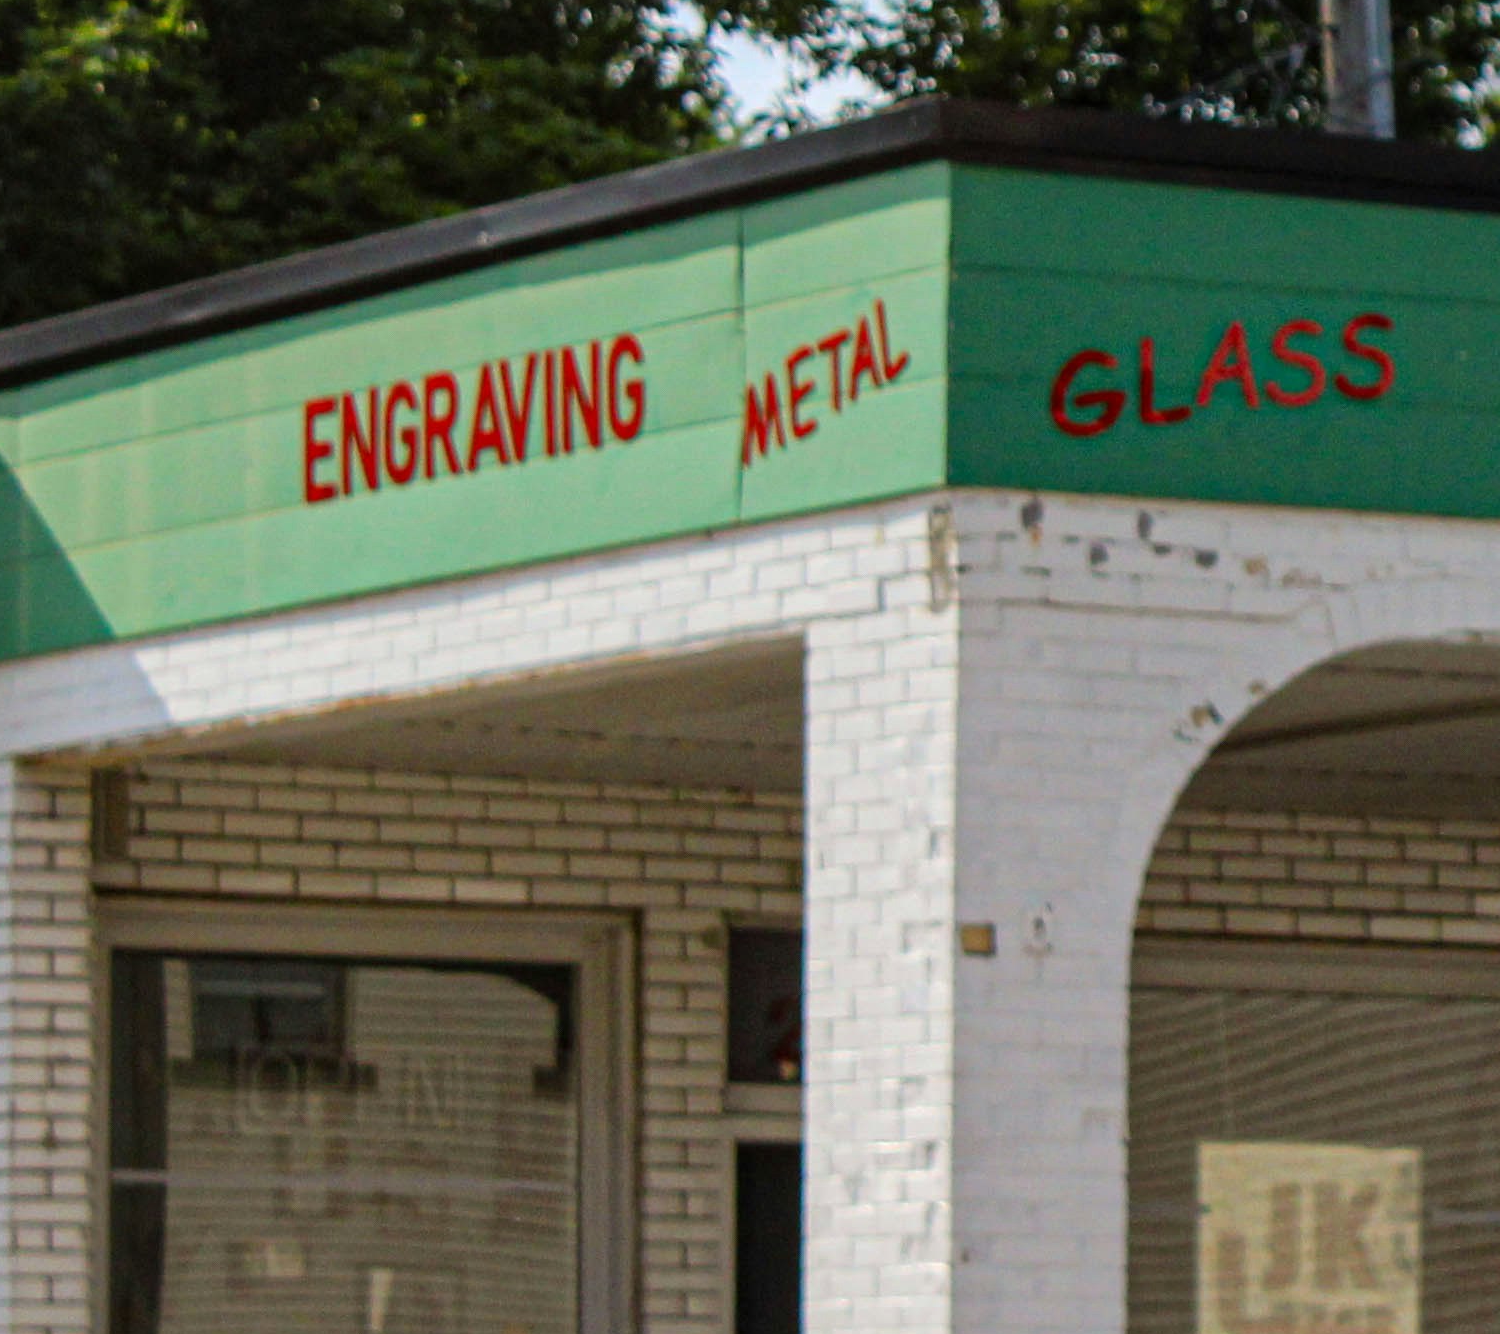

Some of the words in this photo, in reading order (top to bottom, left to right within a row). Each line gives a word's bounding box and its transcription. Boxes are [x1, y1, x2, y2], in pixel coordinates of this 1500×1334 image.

[304, 331, 646, 504] ENGRAVING
[740, 298, 911, 469] METAL
[1049, 313, 1396, 437] GLASS
[250, 1049, 463, 1128] ON
[1261, 1181, 1384, 1289] JK
